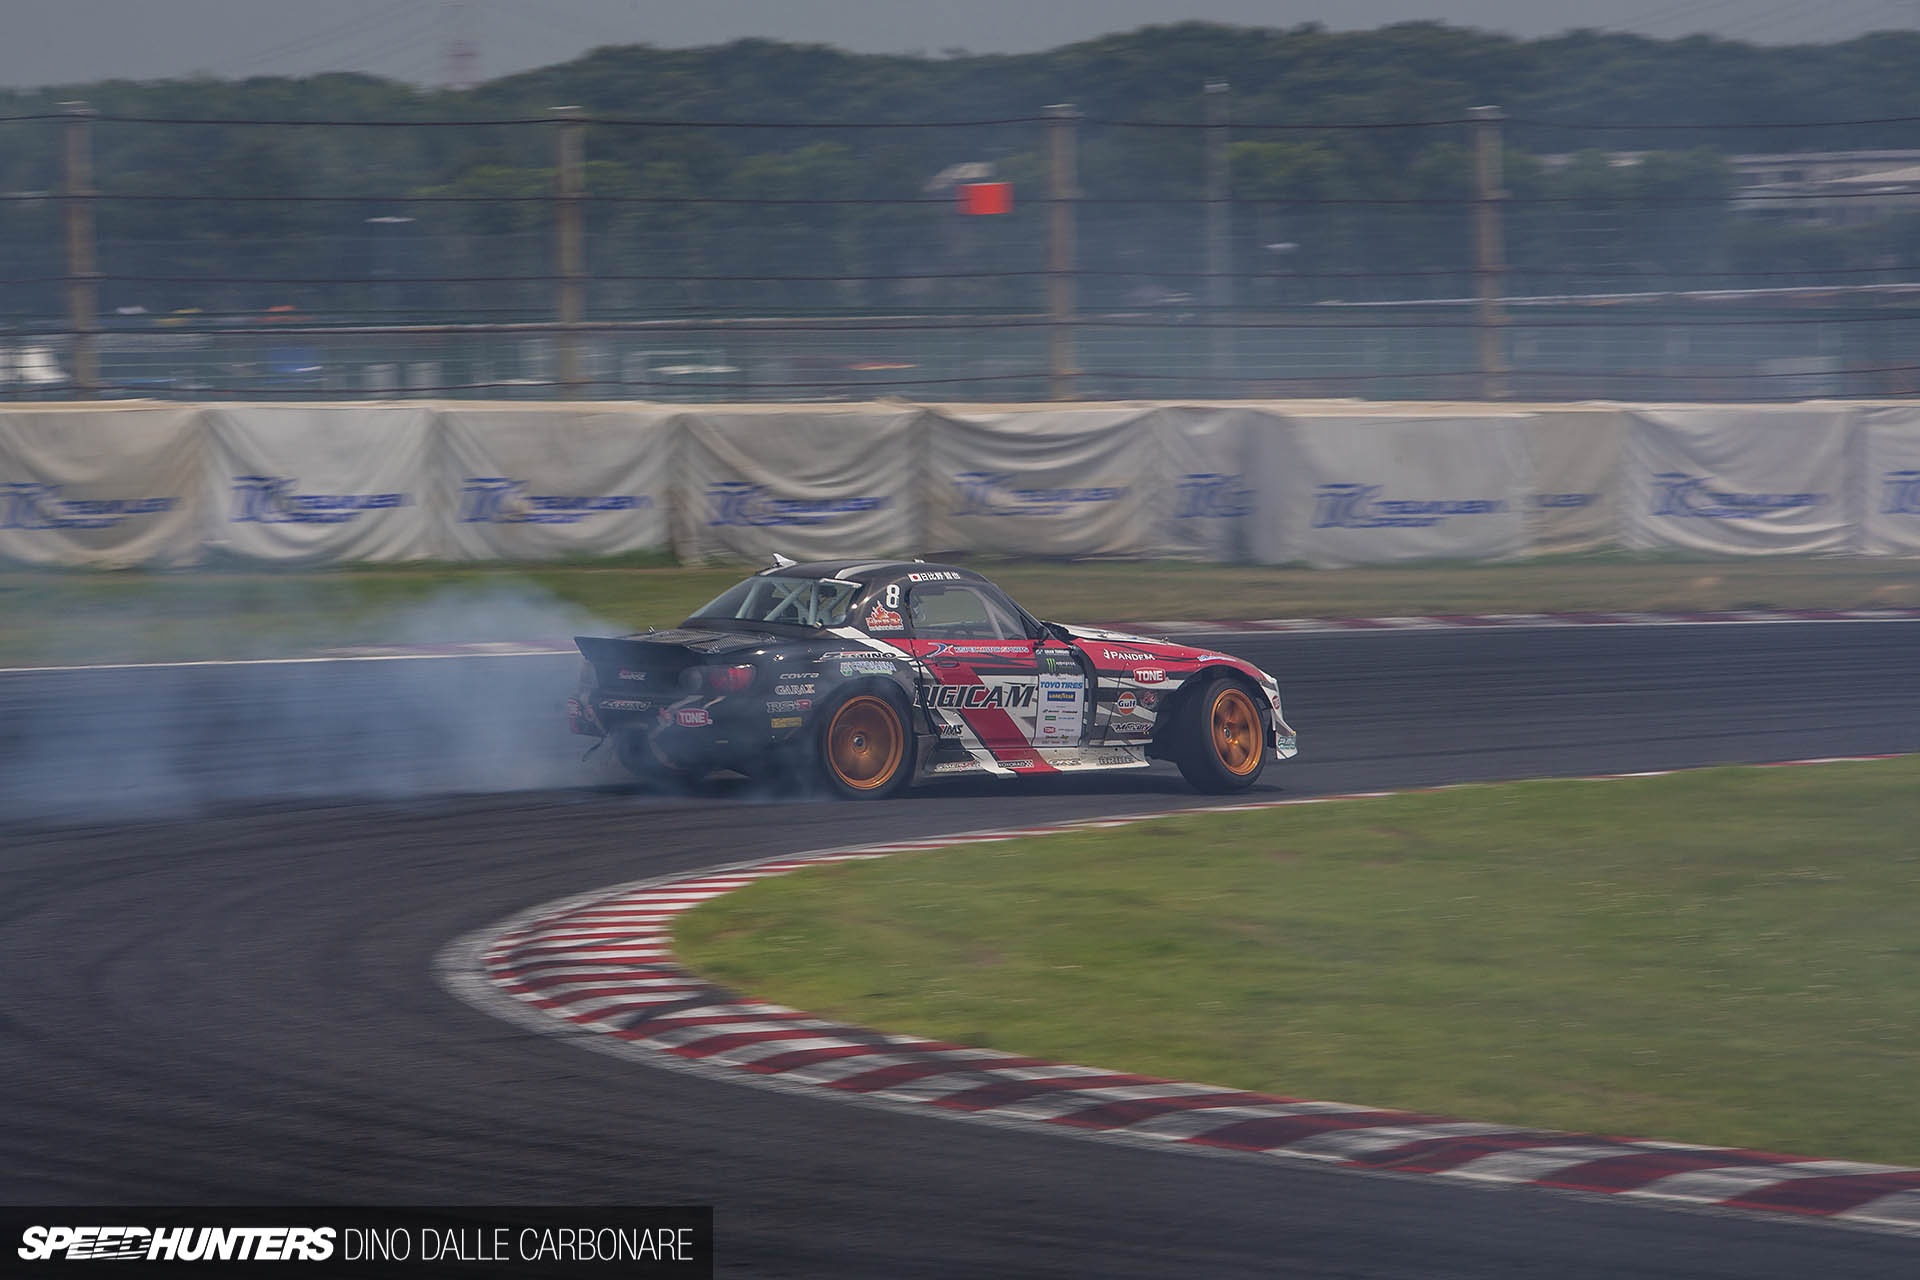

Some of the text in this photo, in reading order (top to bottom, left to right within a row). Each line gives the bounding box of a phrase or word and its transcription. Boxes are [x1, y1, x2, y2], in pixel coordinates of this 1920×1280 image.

[887, 584, 900, 609] 8
[1110, 651, 1156, 661] PANDEM
[1136, 670, 1163, 681] TONE
[774, 684, 815, 695] GARAX
[1118, 700, 1135, 708] Gulf
[679, 714, 705, 725] TONE
